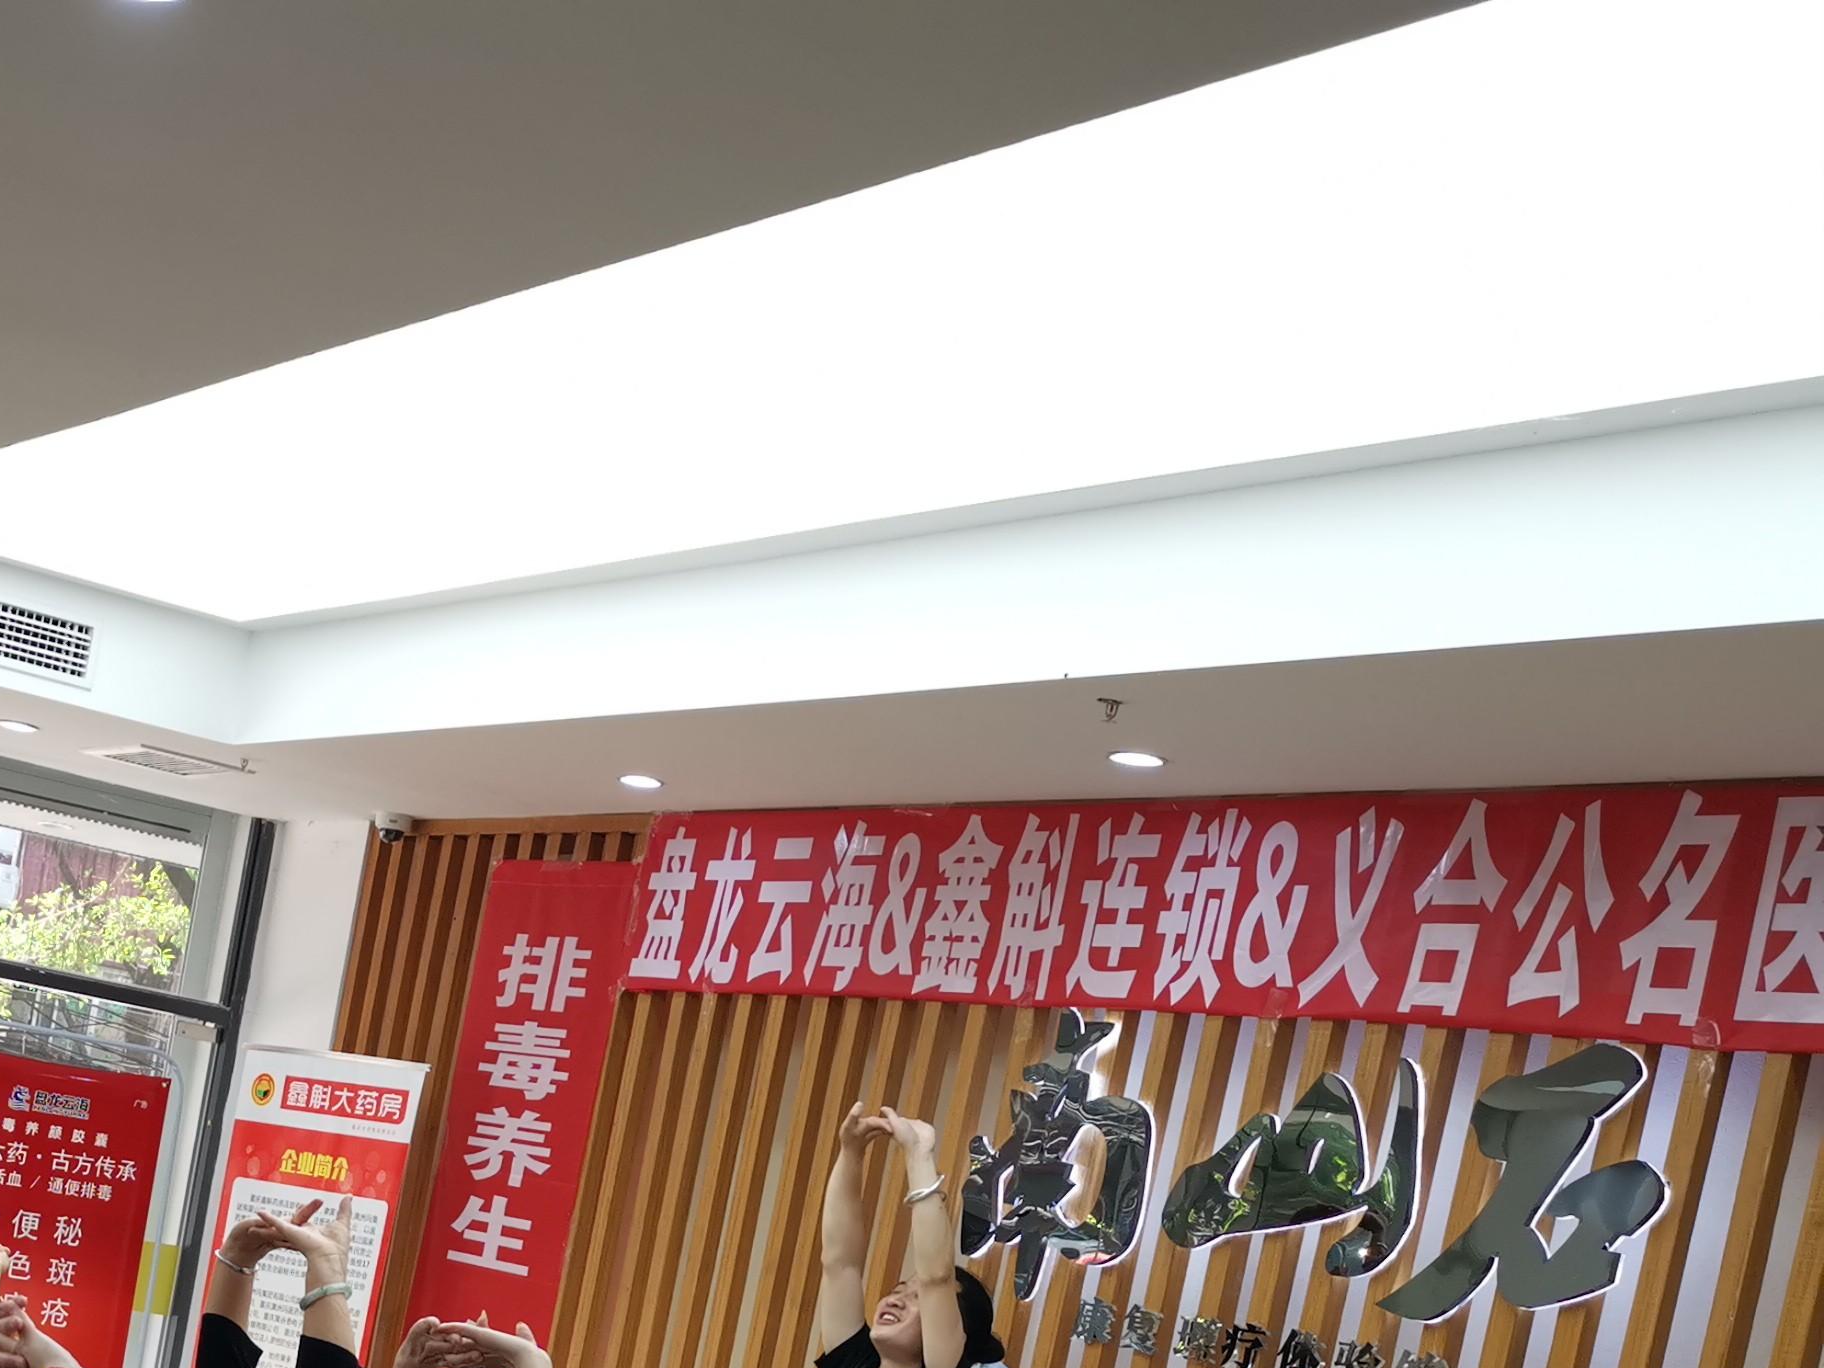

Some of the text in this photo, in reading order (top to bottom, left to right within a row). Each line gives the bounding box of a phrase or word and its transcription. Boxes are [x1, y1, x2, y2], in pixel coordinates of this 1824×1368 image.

[629, 789, 1824, 1026] 盘龙云海&鑫斛连锁&义合公名医
[286, 1081, 404, 1121] 鑫斛大药房
[447, 933, 593, 1276] 排毒养生
[279, 1148, 350, 1182] 企业简介
[47, 1175, 113, 1202] 通便排毒
[11, 1209, 83, 1247] 便秘
[7, 1250, 77, 1287] 色斑
